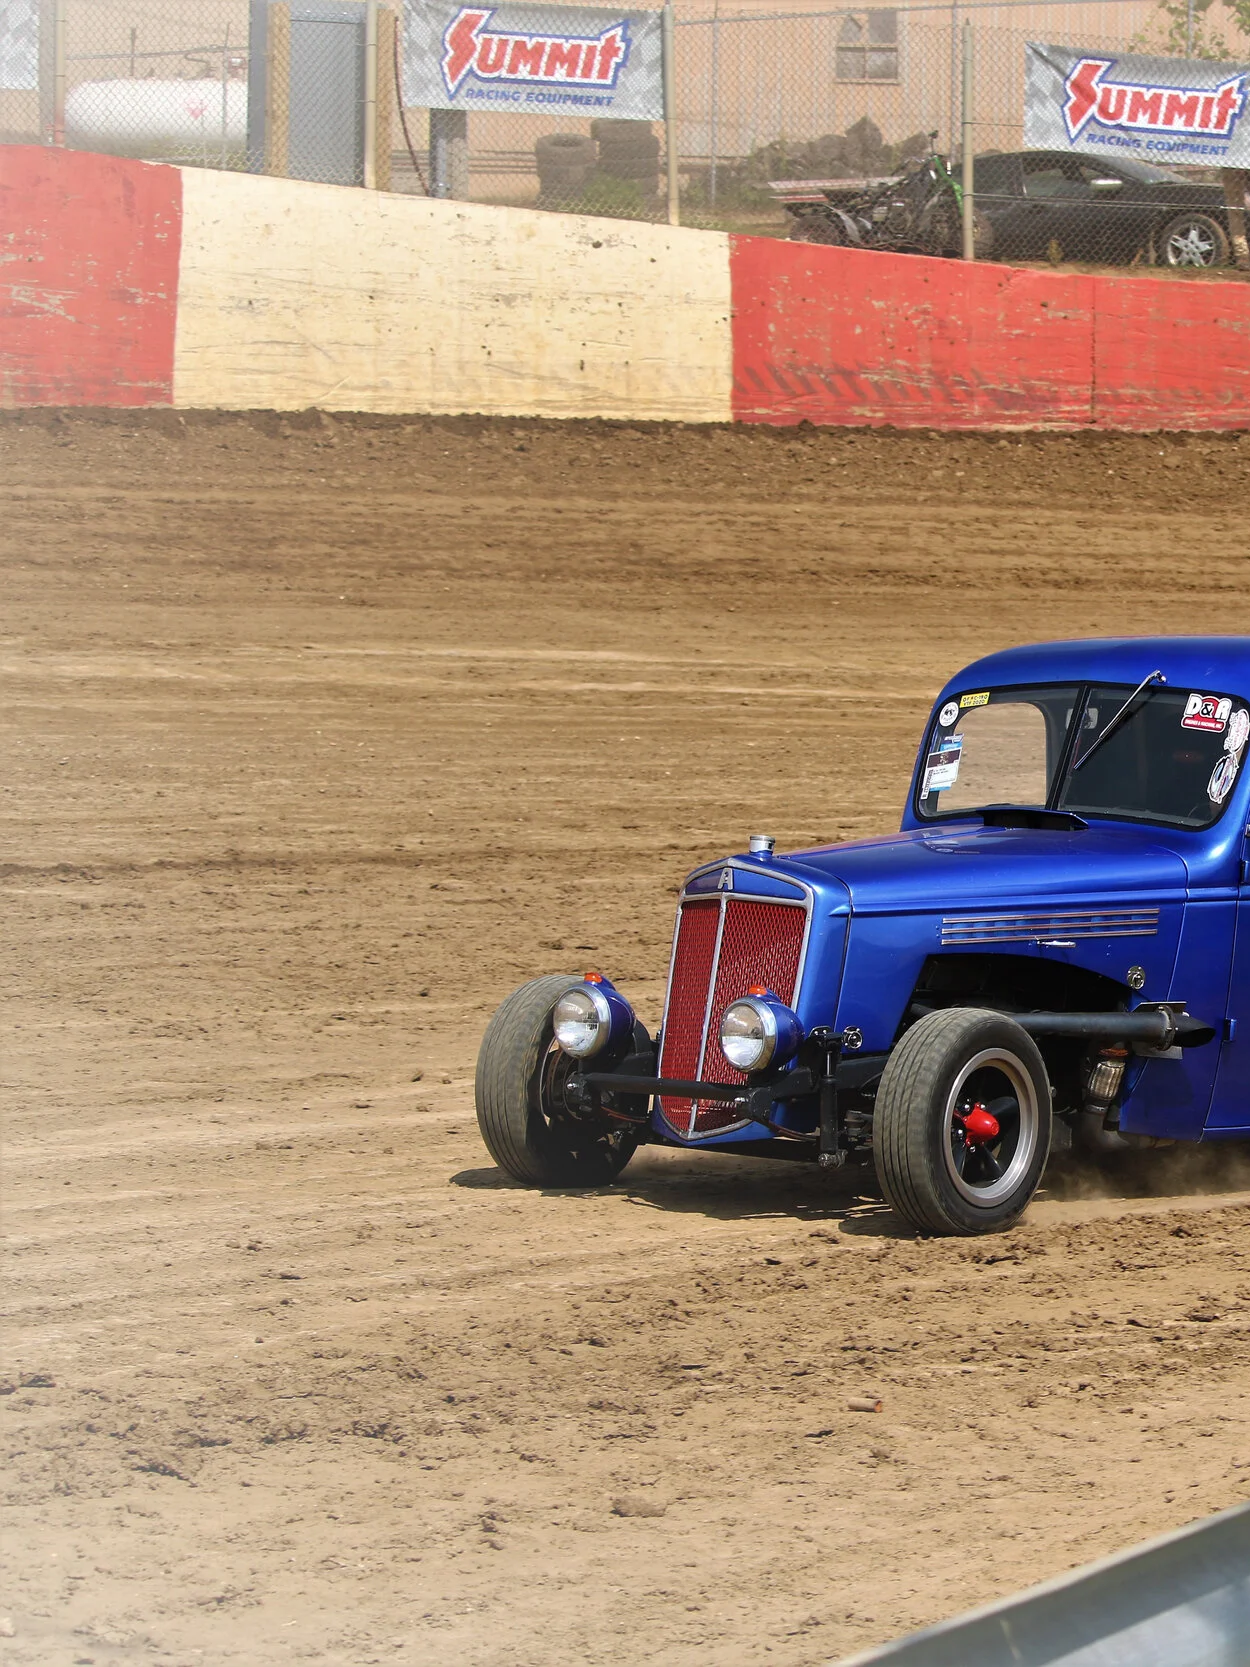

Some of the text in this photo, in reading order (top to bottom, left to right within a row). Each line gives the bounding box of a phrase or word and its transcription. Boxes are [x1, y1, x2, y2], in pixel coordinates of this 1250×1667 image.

[465, 88, 615, 107] RACING EQUIPMENT
[1086, 133, 1229, 156] RACING EQUIPMENT
[1184, 694, 1231, 720] D&R
